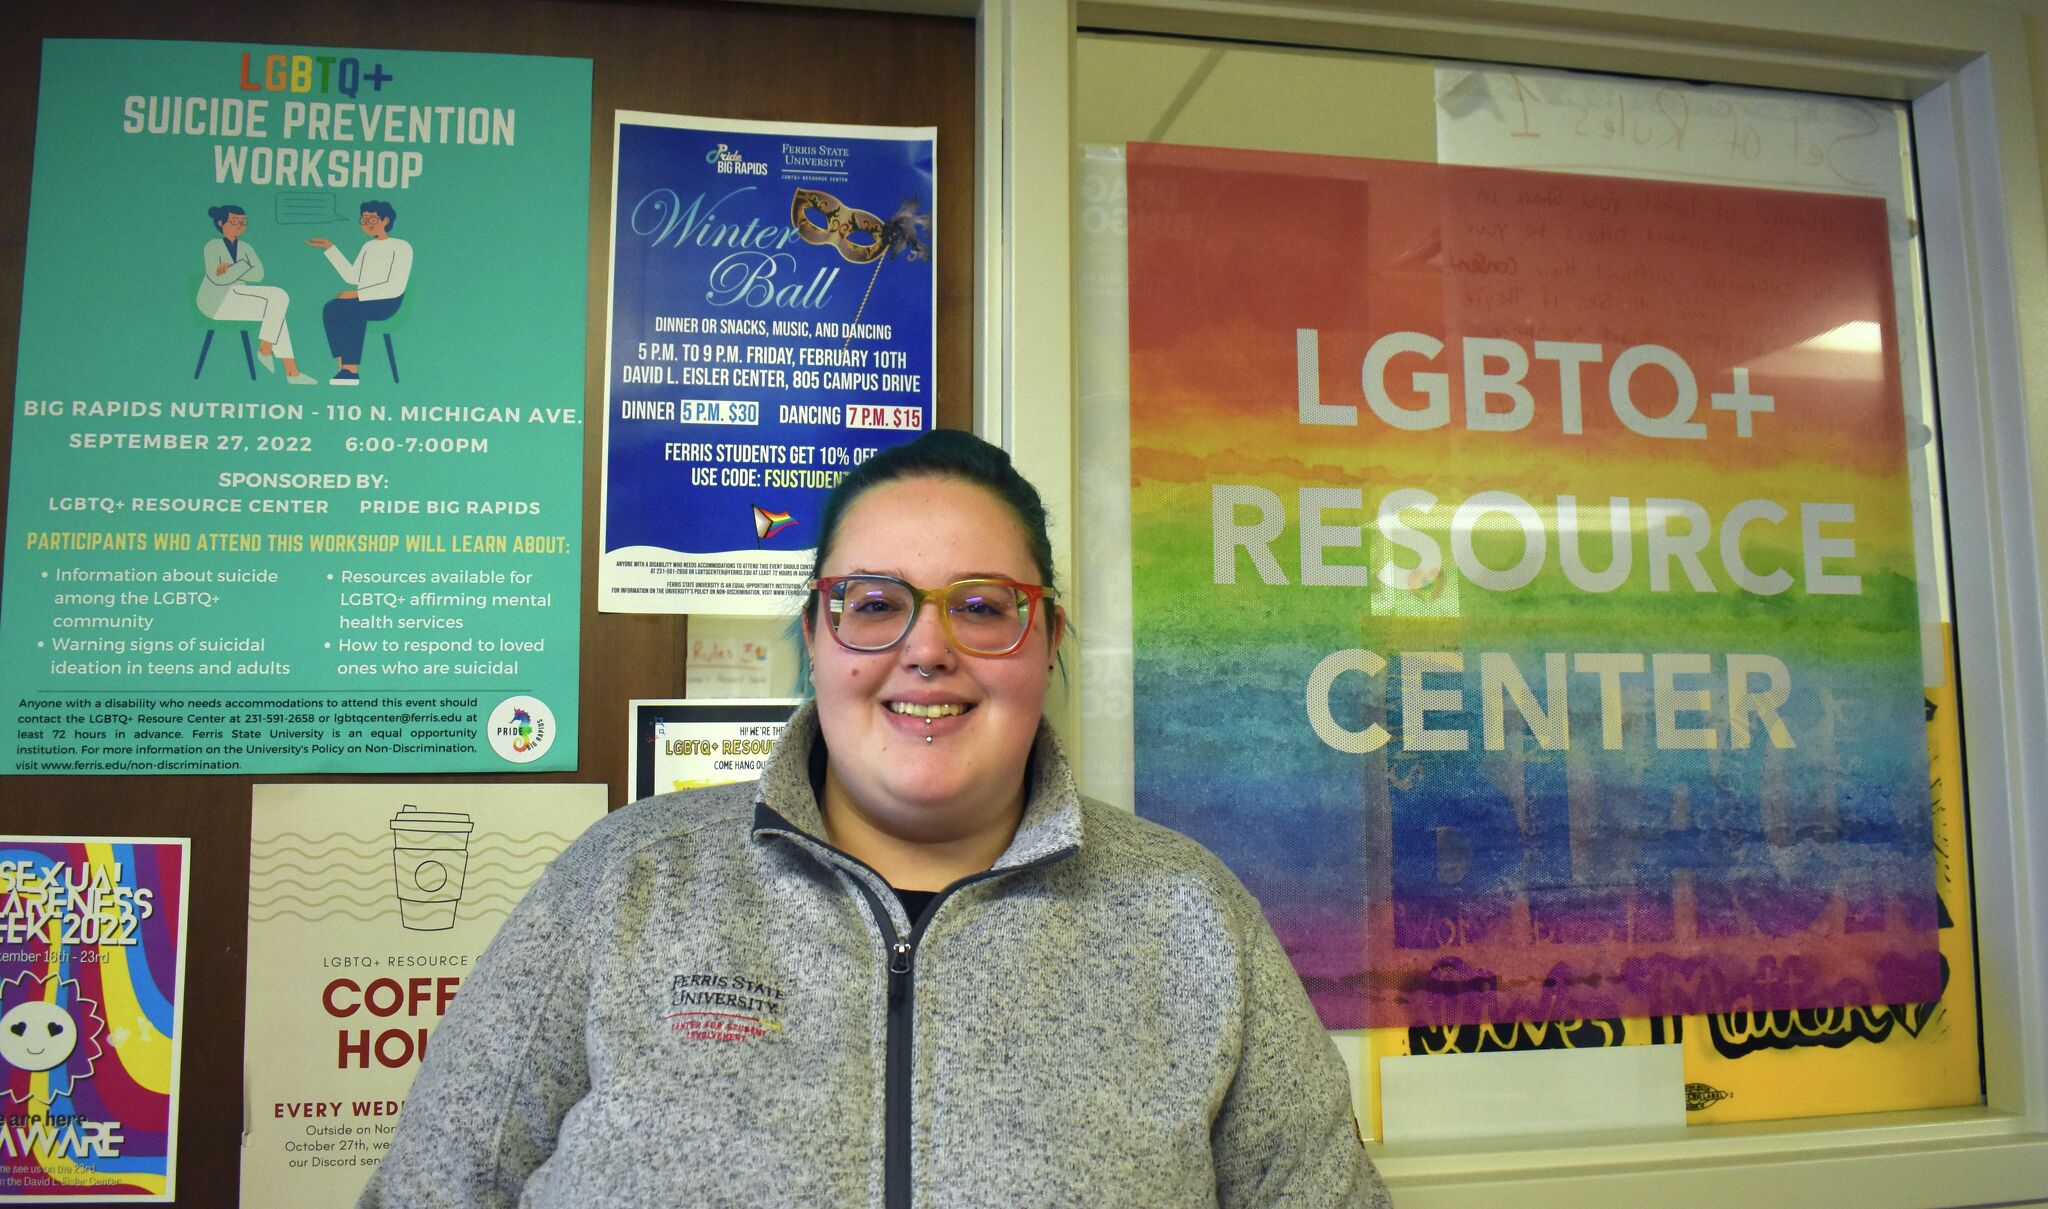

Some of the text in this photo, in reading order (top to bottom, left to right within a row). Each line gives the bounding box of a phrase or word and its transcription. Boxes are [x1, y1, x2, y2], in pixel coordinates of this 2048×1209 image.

[241, 52, 393, 98] LGBTQ+
[124, 96, 515, 146] SUICIDE PREVENTION
[706, 143, 742, 164] Pride
[782, 144, 849, 157] FERRIS STATE
[214, 147, 423, 189] WORKSHOP
[717, 161, 768, 176] BIG RAPIDS
[785, 155, 845, 167] UNIVERSITY
[631, 186, 799, 249] Winter
[706, 251, 839, 308] Ball
[656, 317, 891, 340] DINNER OR SNACKS, MUSIC, AND DANCING
[638, 343, 906, 369] 5 P.M. TO 9 P.M. FRIDAY, FEBRUARY 10TH
[623, 365, 920, 392] DAVID L. EISLER CENTER, 805 CAMPUS DRIVE
[1295, 327, 1776, 440] LGBTQ+
[25, 400, 585, 424] BIG RAPIDS NUTRITION 110 N. MICHIGAN AVE.
[622, 401, 920, 428] DINNER 5 P.M. $30 DANCING 7 P.M. $15
[70, 434, 488, 453] SEPTEMBER 27, 2022 6:00-7:00PM
[665, 443, 713, 462] FERRIS
[716, 444, 786, 464] STUDENTS
[790, 446, 815, 464] GET
[820, 447, 850, 466] 10%
[219, 473, 388, 489] SPONSORED BY:
[692, 467, 718, 486] USE
[721, 468, 761, 487] CODE:
[50, 498, 328, 513] LGBTQ+ RESOURCE CENTER
[360, 501, 540, 515] PRIDE BIG RAPIDS
[27, 532, 570, 554] PARTICIPANTS WHO ATTEND THIS WORKSHOP WILL LEARN ABOUT:
[1211, 482, 1863, 596] RESOURCE
[57, 568, 278, 583] Information about suicide
[55, 592, 220, 608] among the LGBTQ+
[53, 615, 154, 631] community
[52, 637, 265, 654] Warning signs of suicidal
[19, 699, 62, 710] Anyone
[66, 699, 91, 708] with
[105, 699, 157, 710] disability
[160, 699, 184, 708] who
[188, 699, 222, 708] needs
[225, 699, 323, 708] accommodations
[327, 699, 338, 709] to
[342, 698, 378, 707] attend
[382, 698, 402, 708] this
[406, 699, 436, 708] event
[440, 698, 479, 707] should
[1304, 648, 1797, 755] CENTER
[497, 727, 524, 736] PRIDE
[666, 740, 719, 756] LGBTQ+
[16, 760, 241, 770] visit www.ferris.edu/non-discrimination.
[714, 760, 733, 770] COME
[735, 760, 755, 770] HANG
[62, 913, 138, 945] 2022
[324, 956, 467, 968] LGBTQ+ RESOURCE
[672, 975, 786, 1000] FERRIS STATE
[322, 977, 462, 1018] COFF
[672, 991, 778, 1013] UNIVERSITY
[275, 1102, 342, 1118] EVERY
[306, 1124, 352, 1136] Outside
[356, 1127, 371, 1135] on
[285, 1139, 369, 1152] October 27th,
[289, 1155, 356, 1168] our Discord
